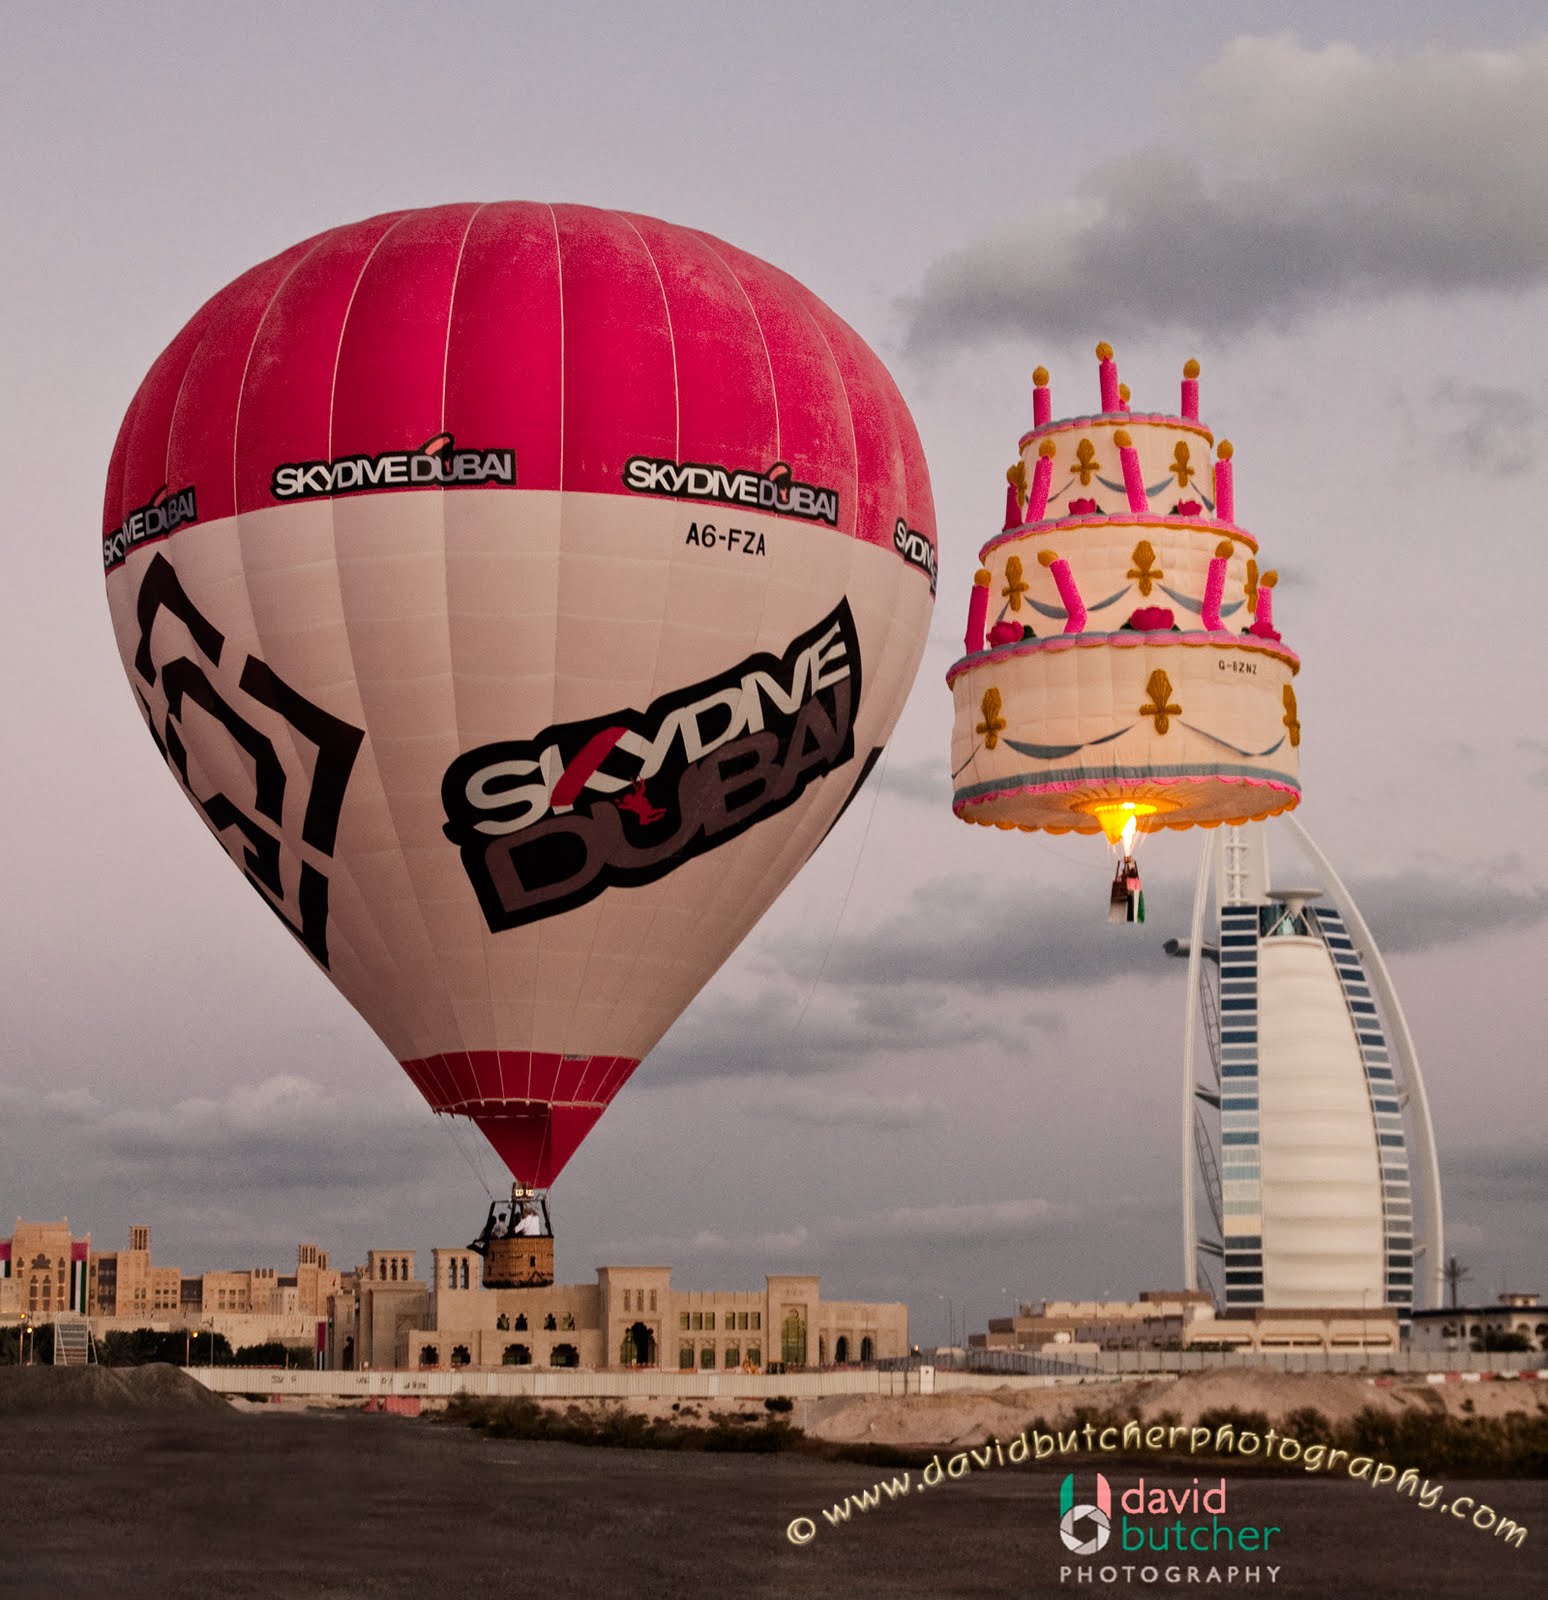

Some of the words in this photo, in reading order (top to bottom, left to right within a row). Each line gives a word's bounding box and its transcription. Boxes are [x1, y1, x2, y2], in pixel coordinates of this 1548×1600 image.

[275, 455, 408, 495] SKYDIVE
[410, 453, 512, 482] DUBAI
[626, 459, 758, 502] SKYDIVE
[759, 479, 837, 521] DUBAI
[685, 522, 766, 556] A6-FZA
[465, 620, 851, 836] SKYDIVE
[484, 678, 853, 914] DUBAI
